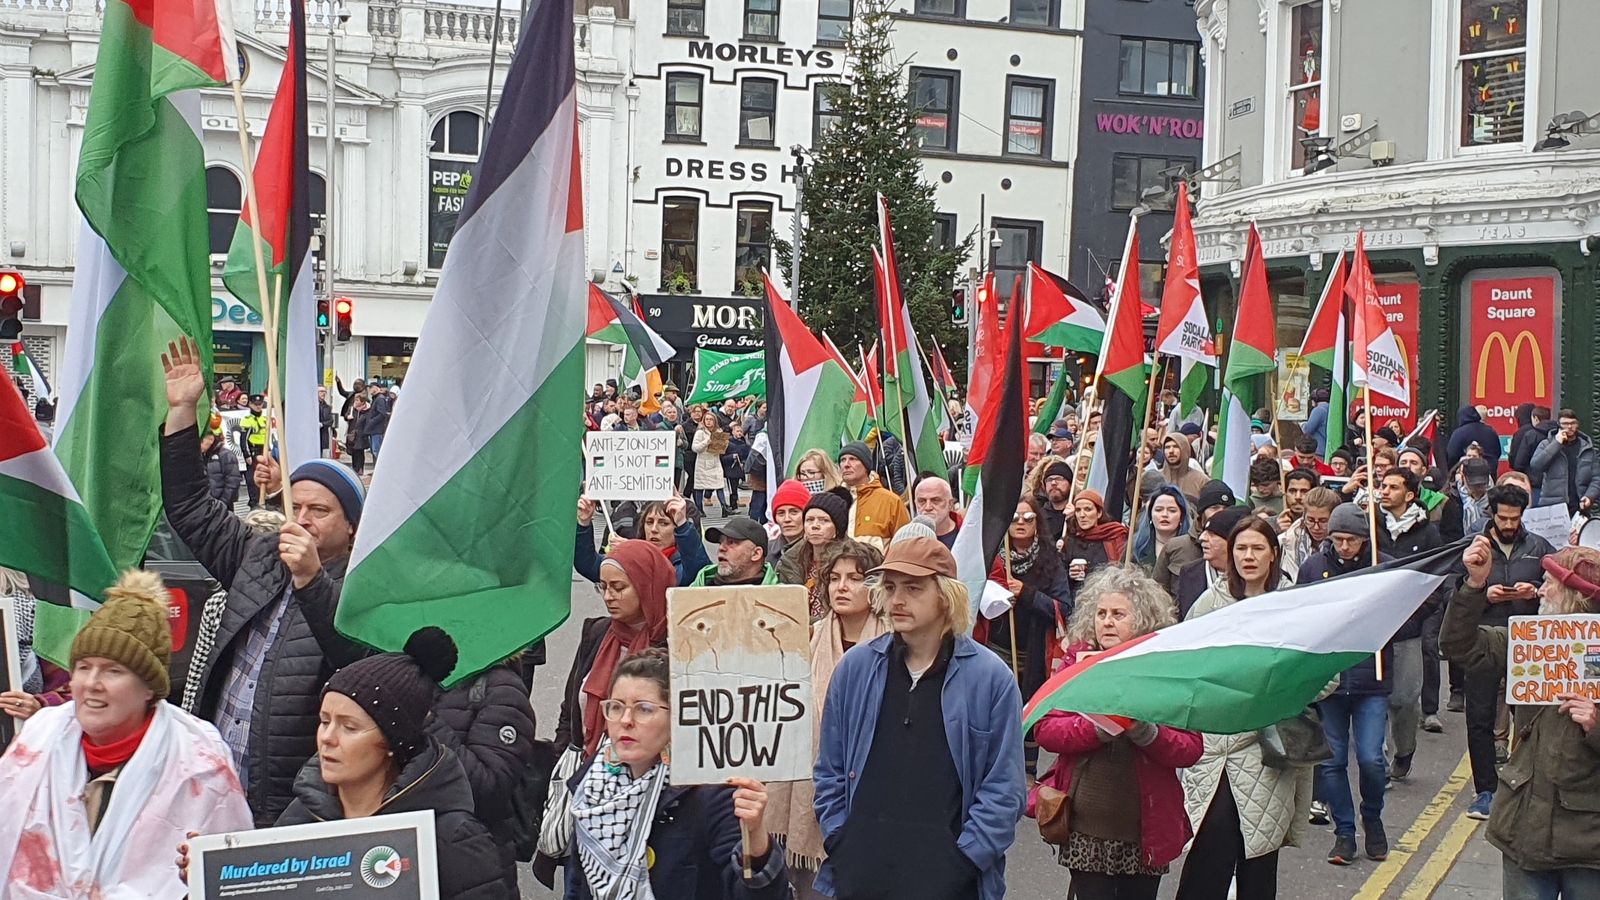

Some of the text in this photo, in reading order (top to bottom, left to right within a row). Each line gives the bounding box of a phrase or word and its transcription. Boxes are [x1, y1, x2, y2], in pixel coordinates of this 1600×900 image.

[688, 41, 834, 68] MORLEYS
[666, 158, 807, 184] DRESS H
[1478, 226, 1526, 240] TEAS
[1378, 293, 1401, 306] aunt
[1491, 287, 1533, 301] Daunt
[211, 297, 263, 324] Dea
[649, 307, 662, 318] 90
[1386, 312, 1404, 322] are
[1487, 306, 1536, 321] Square
[403, 341, 416, 350] PE
[696, 333, 733, 347] Gents
[1366, 361, 1395, 380] PARTY
[613, 454, 651, 469] IS NOT
[169, 605, 181, 618] EE
[1543, 660, 1579, 681] WAR
[679, 683, 805, 726] END THIS
[698, 722, 783, 769] NOW
[219, 851, 352, 880] Murdered by Israel
